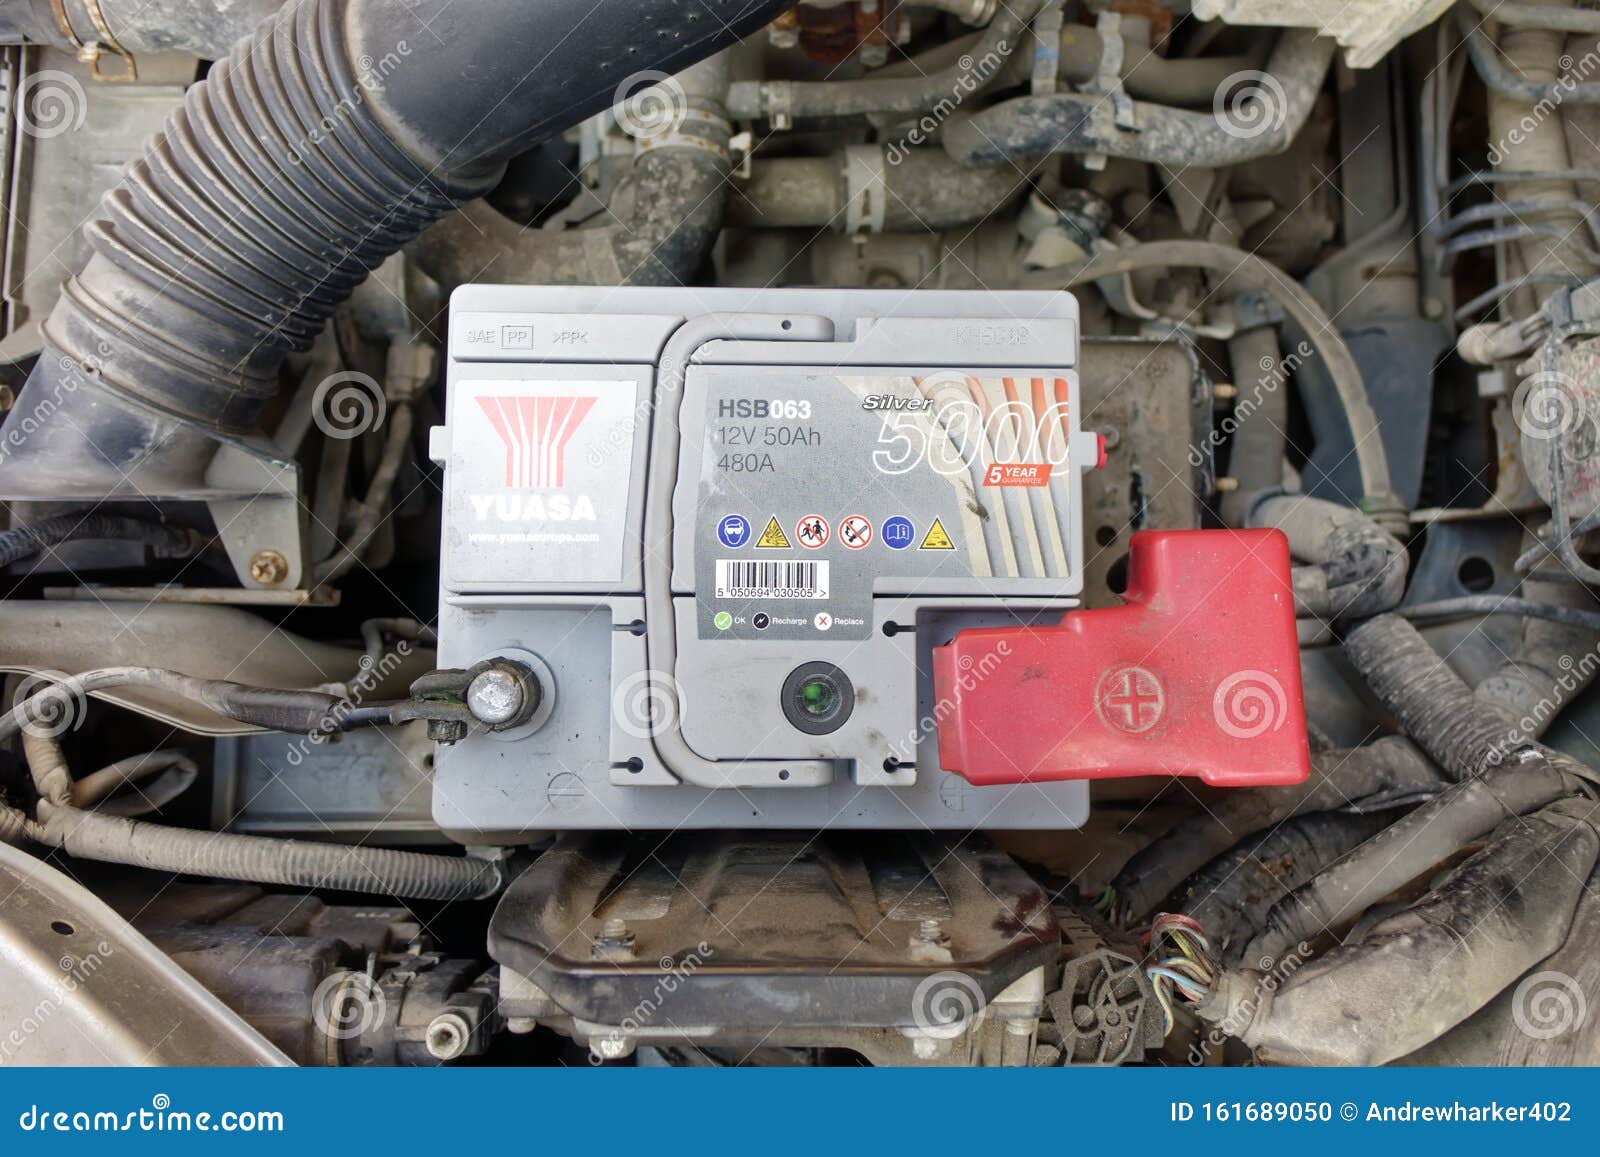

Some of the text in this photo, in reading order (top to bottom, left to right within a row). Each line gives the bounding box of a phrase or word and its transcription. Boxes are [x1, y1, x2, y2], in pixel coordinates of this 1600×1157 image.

[506, 331, 529, 345] PP
[718, 399, 812, 420] HSB063
[862, 394, 935, 412] Silver
[718, 427, 821, 446] 12V 50Ah
[717, 454, 775, 473] 480A
[989, 466, 1038, 484] 5 YEAR
[470, 495, 597, 521] YUASA
[717, 587, 724, 598] 5
[730, 587, 770, 598] 050694
[774, 587, 813, 598] 030505
[734, 616, 746, 625] OK
[772, 616, 807, 627] Recharge
[834, 616, 864, 627] Replace
